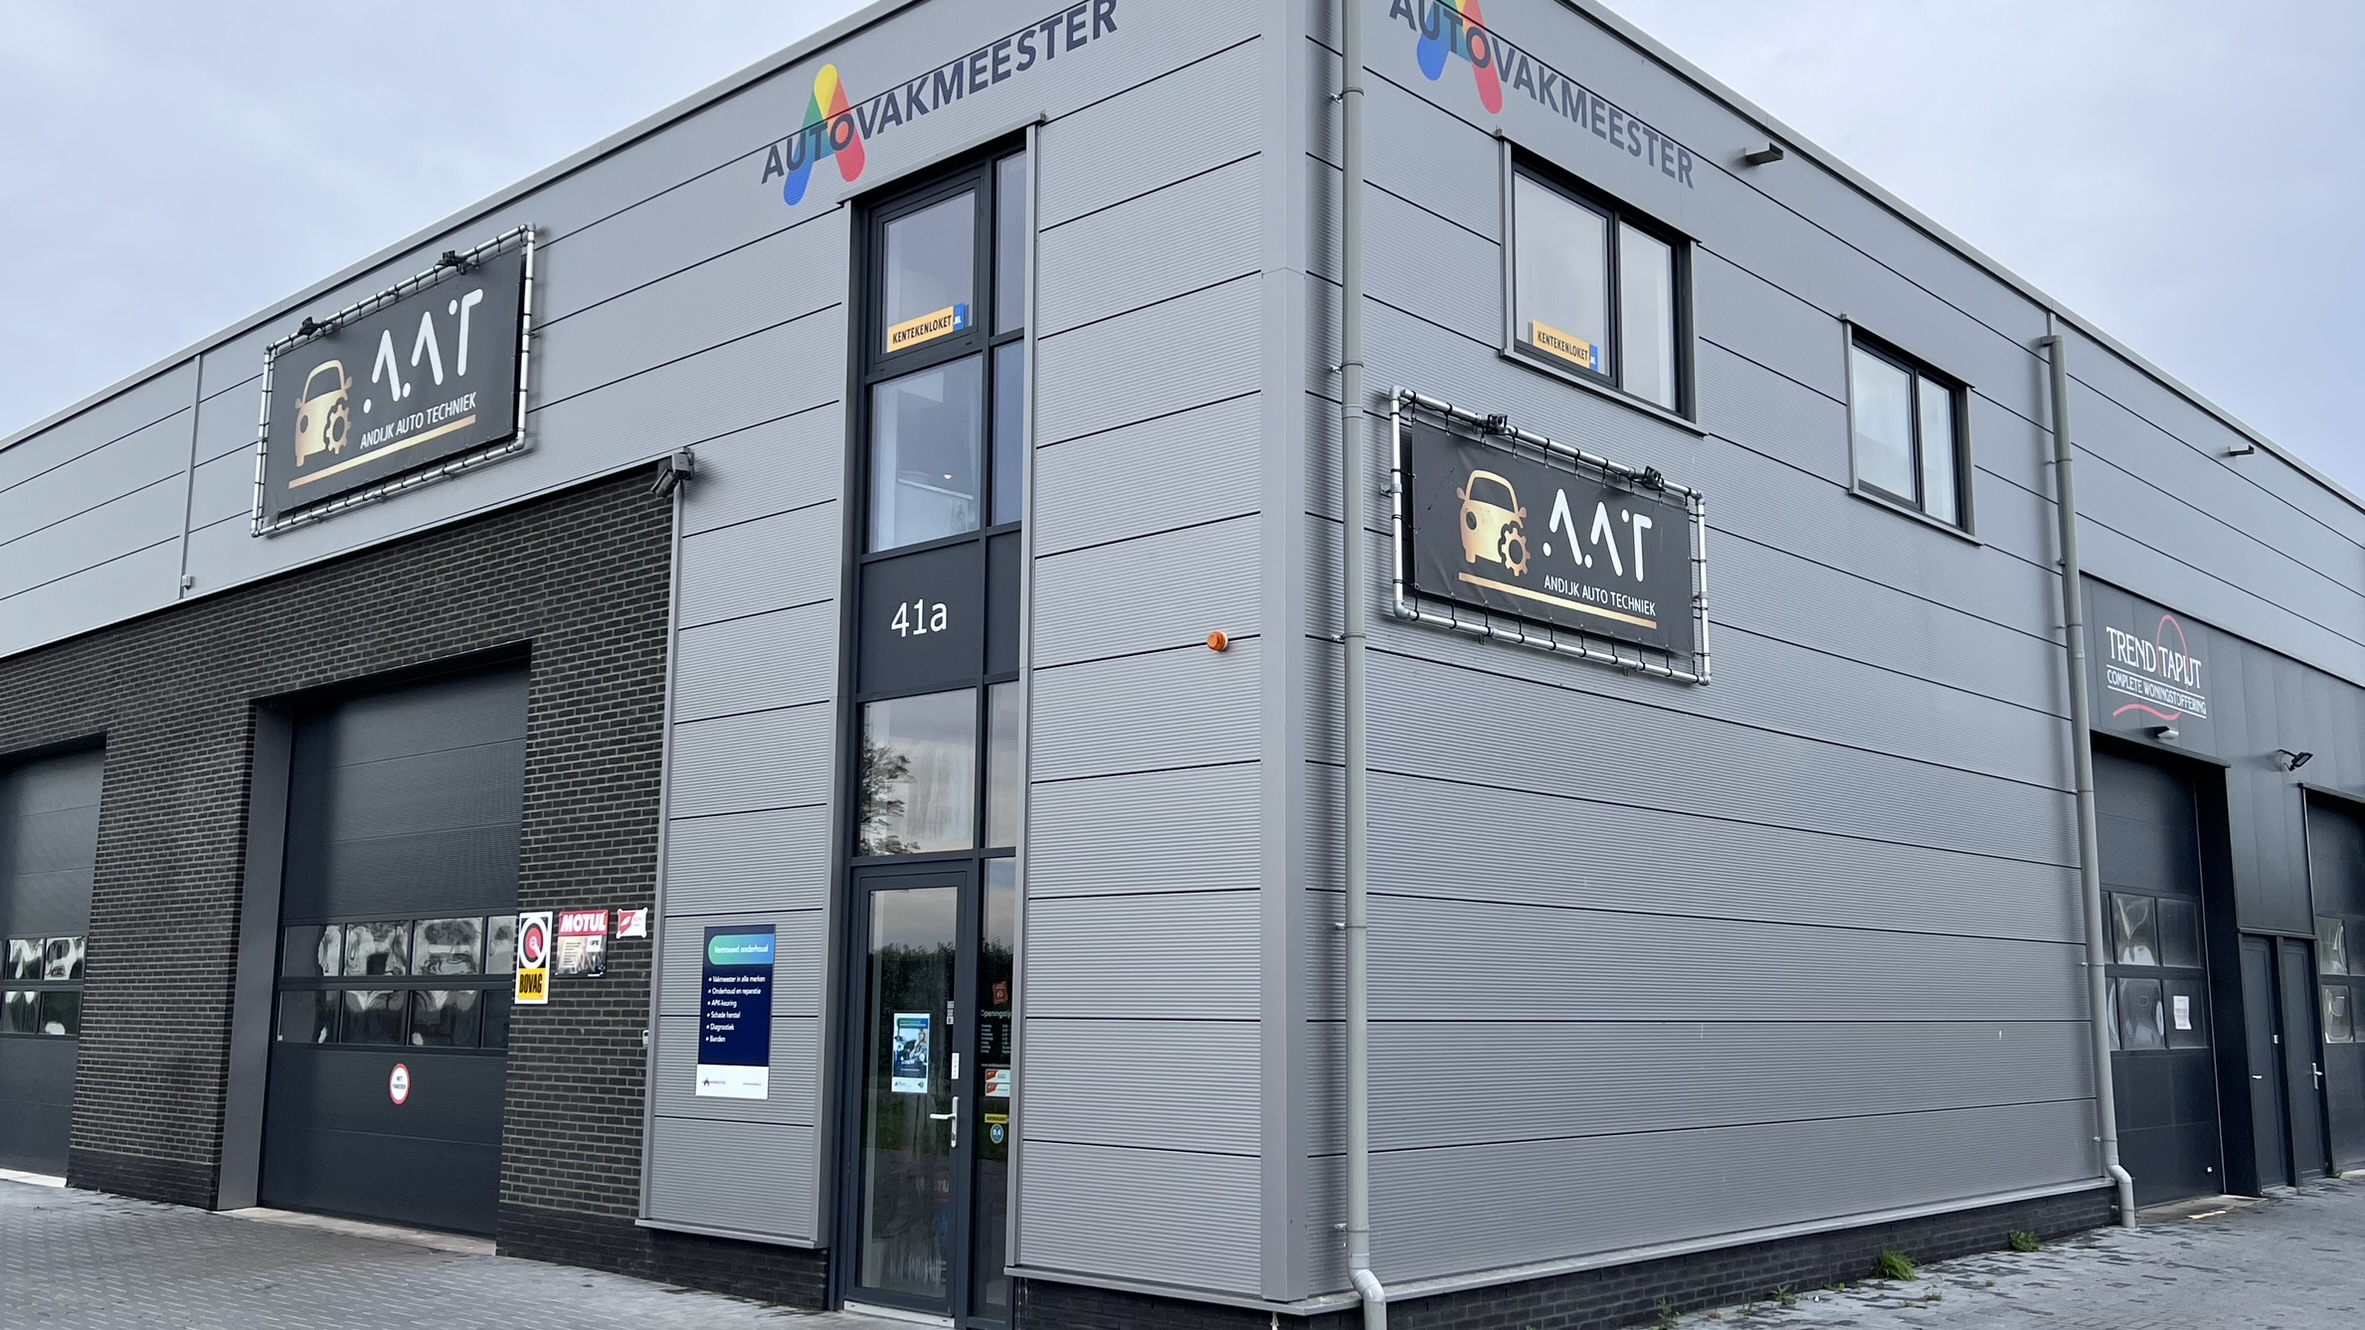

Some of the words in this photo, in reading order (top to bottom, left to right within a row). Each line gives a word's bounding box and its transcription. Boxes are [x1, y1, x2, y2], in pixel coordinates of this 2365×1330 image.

[761, 0, 1118, 185] AUTOVAKMEESTER
[1389, 0, 1694, 189] AUTOVAKMEESTER
[892, 315, 952, 344] KENTEKENLOKET
[1537, 330, 1588, 361] KENTEKENLOKET
[360, 422, 395, 450] ANDIJK
[396, 412, 424, 436] AUTO
[426, 391, 477, 425] TECHNIEK
[1544, 574, 1580, 597] ANDIJK
[1582, 584, 1608, 604] AUTO
[1610, 591, 1656, 616] TECHNIEK
[891, 598, 947, 637] 41a
[2106, 626, 2157, 672] TREND
[2159, 646, 2202, 688] TAPIJT
[2107, 669, 2143, 694] COMPLETE
[2143, 680, 2207, 715] WONINGSTOFFERING
[560, 912, 606, 932] MOTUL
[519, 973, 542, 994] BOVAG
